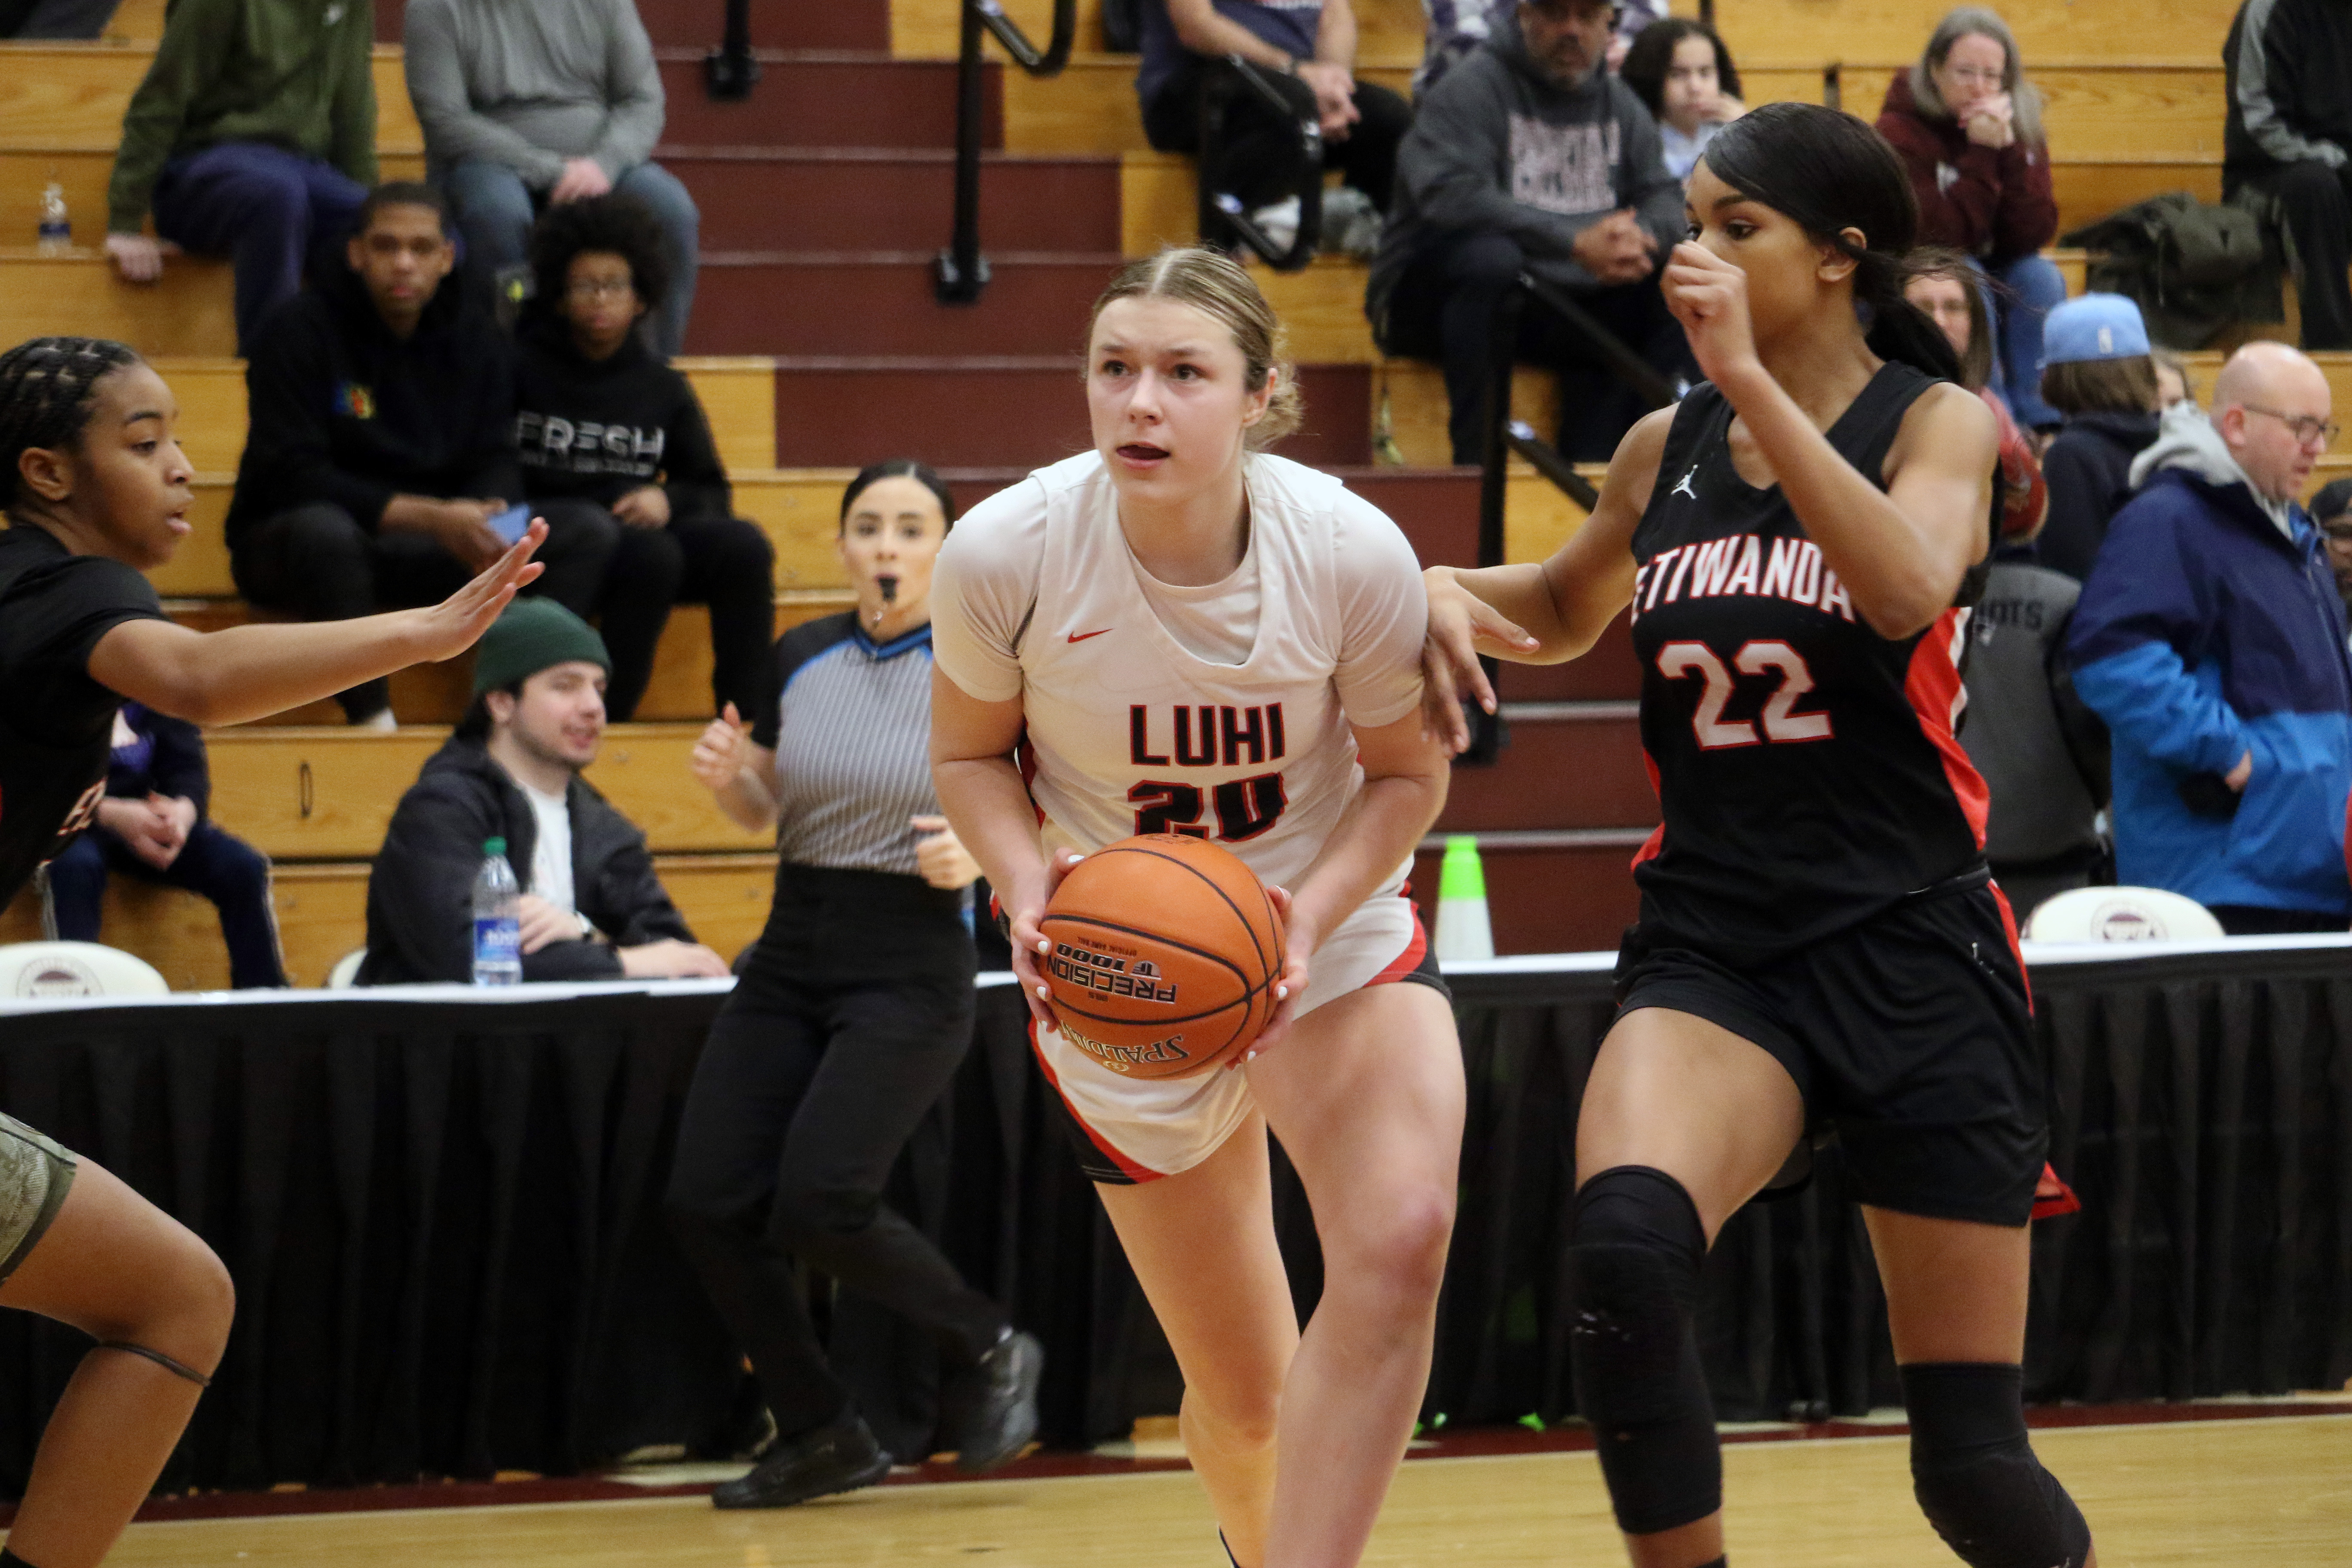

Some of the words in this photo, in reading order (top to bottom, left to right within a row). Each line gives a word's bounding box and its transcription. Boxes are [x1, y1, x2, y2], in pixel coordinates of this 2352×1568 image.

[1655, 639, 1835, 751] 22
[1130, 702, 1285, 766] LUHI
[1127, 772, 1289, 843] 20
[1046, 954, 1178, 1004] PRECISION
[1057, 942, 1126, 974] 1000
